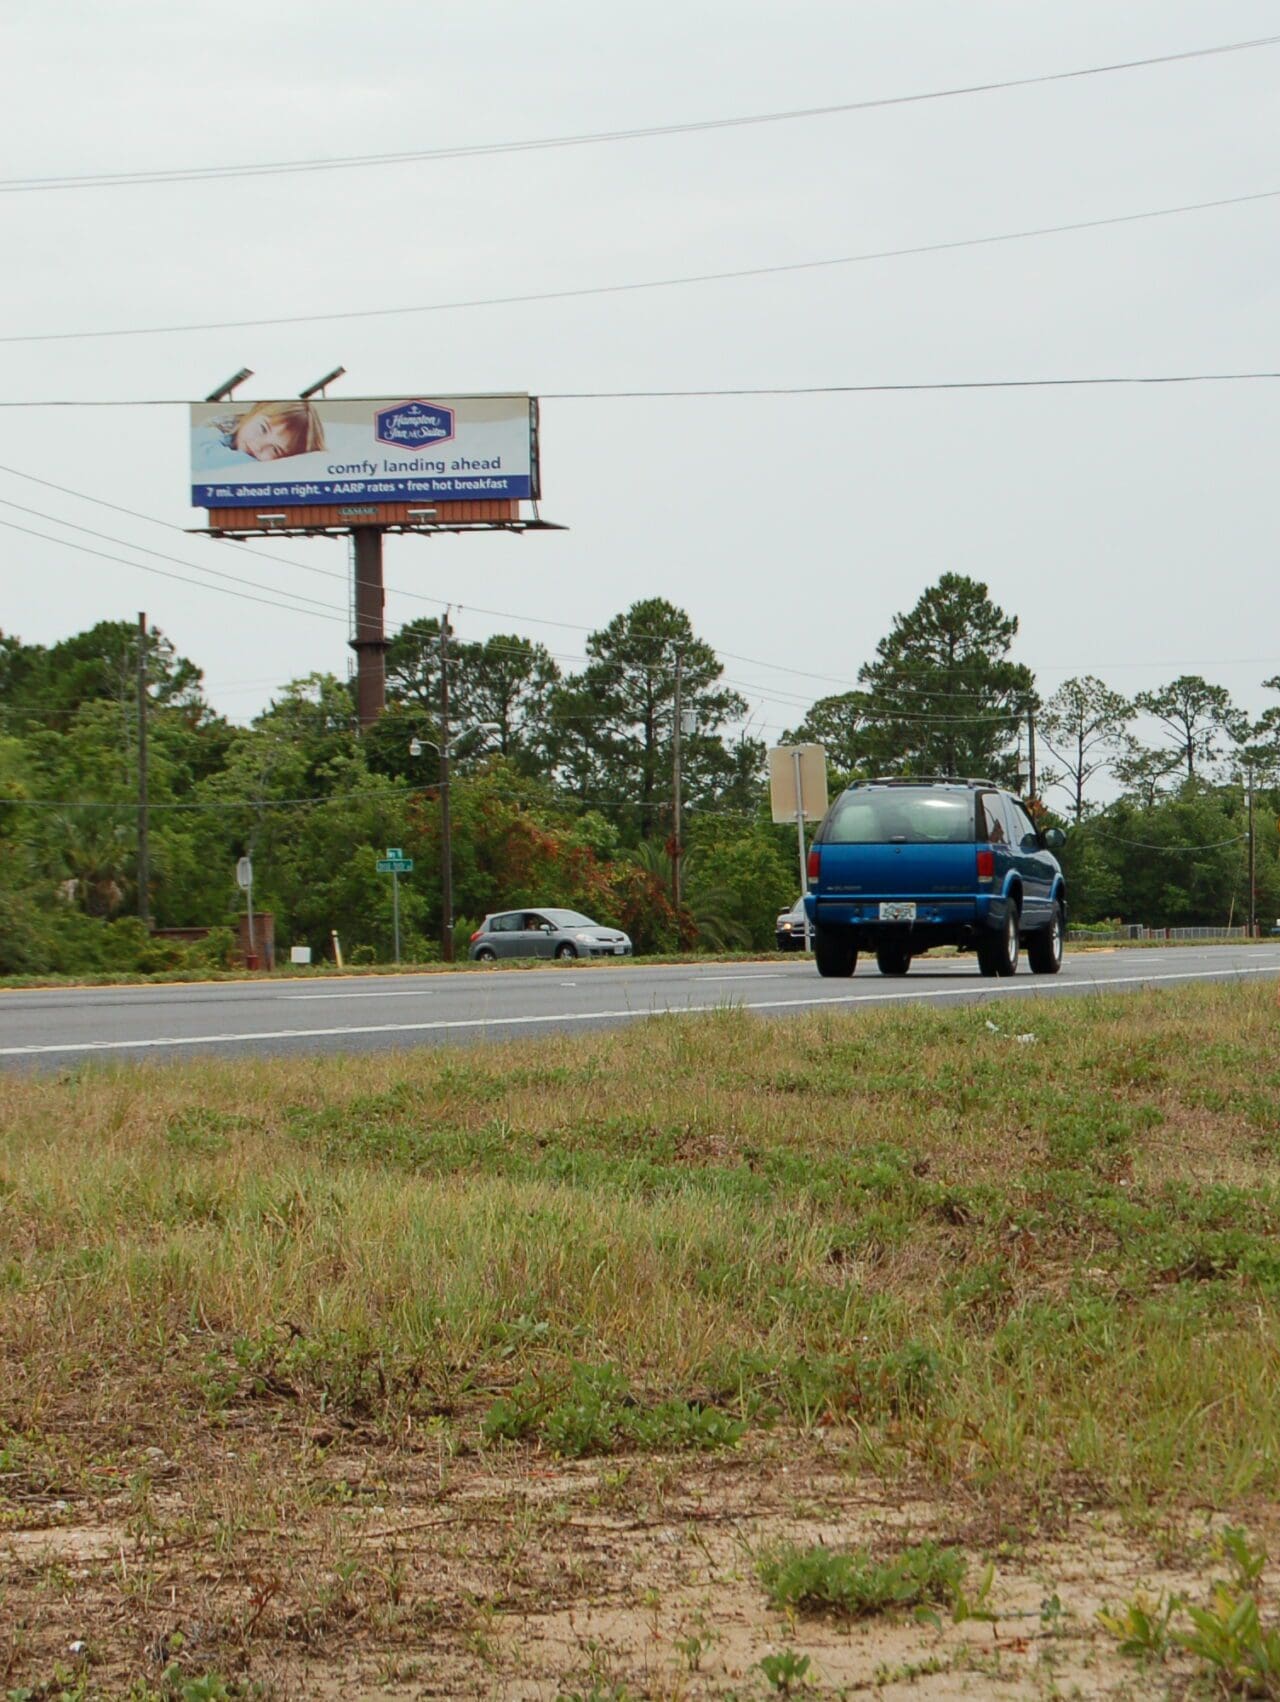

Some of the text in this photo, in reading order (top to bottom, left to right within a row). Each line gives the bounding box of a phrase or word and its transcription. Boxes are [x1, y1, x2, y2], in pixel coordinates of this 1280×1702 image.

[385, 414, 441, 429] Hampton
[417, 426, 447, 438] Suites
[327, 456, 501, 476] comfy landing ahead
[206, 487, 214, 497] 7
[215, 487, 235, 498] mi.
[236, 485, 272, 497] ahead
[273, 487, 289, 496] on
[333, 482, 366, 494] AARP
[367, 483, 396, 493] rates
[407, 480, 429, 491] free
[432, 479, 452, 491] hot
[454, 478, 508, 490] breakfast
